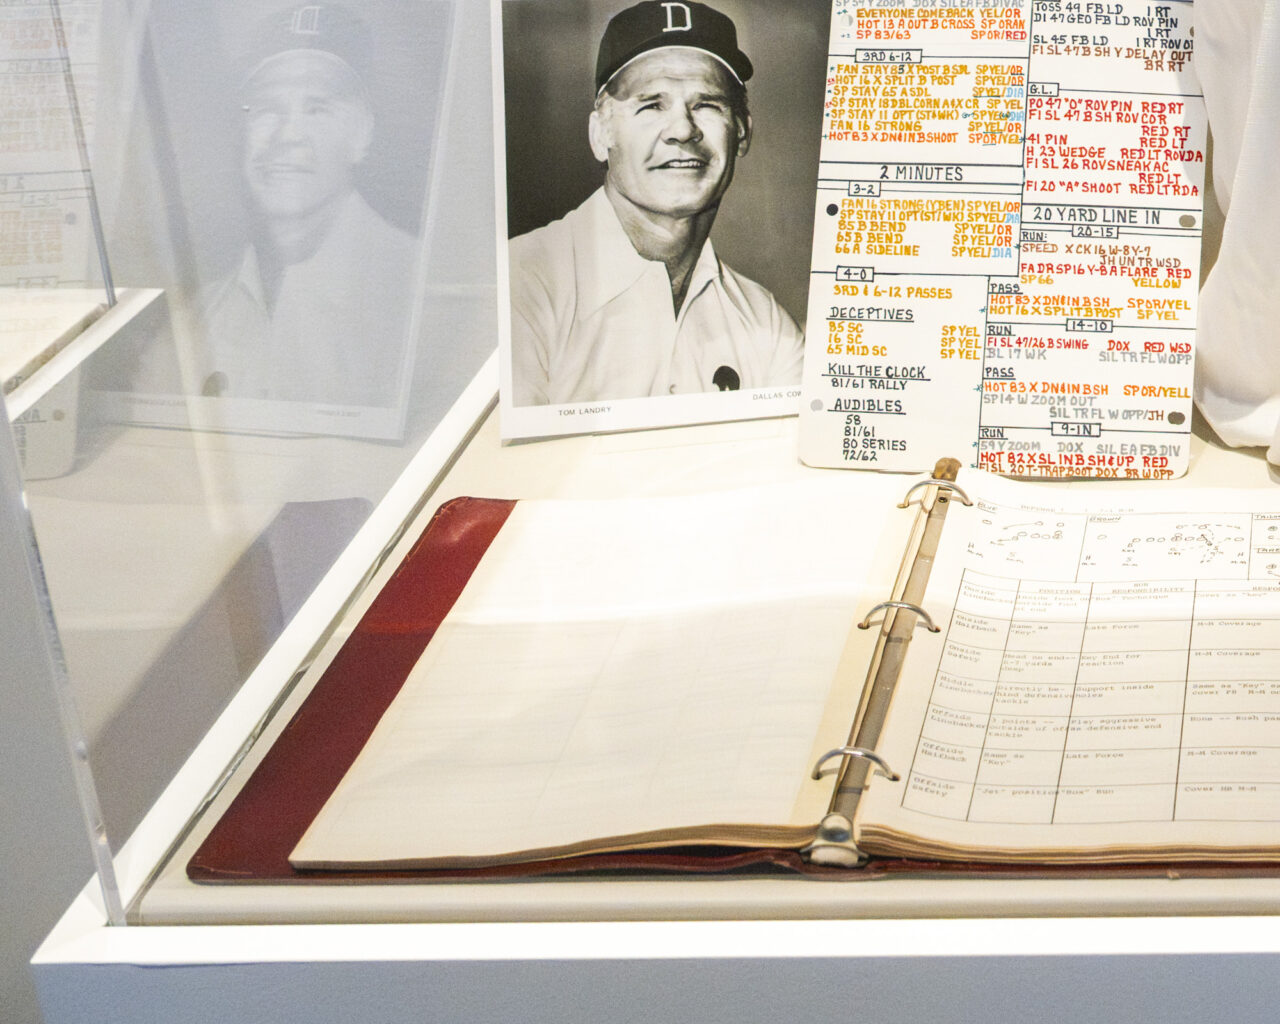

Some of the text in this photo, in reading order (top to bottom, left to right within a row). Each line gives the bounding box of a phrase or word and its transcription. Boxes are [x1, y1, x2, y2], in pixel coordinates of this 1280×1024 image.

[661, 2, 692, 32] D
[856, 9, 1021, 18] EVERYONE COMEBACK YEL/OR
[863, 52, 912, 61] 3RD 6-12
[1030, 85, 1052, 94] G.L.
[1027, 134, 1068, 144] 41 PIN
[1140, 137, 1187, 148] RED LT
[880, 166, 963, 180] 2 MINUTES
[853, 184, 875, 194] 3-2
[1034, 207, 1160, 225] 20 YARD LINE IN
[1078, 227, 1114, 237] 20-15
[844, 269, 867, 279] 4-0
[1132, 278, 1181, 288] YELLOW
[833, 285, 859, 295] 3RD
[874, 286, 901, 297] 6-12
[907, 287, 952, 299] PASSES
[831, 307, 913, 320] DECEPTIVES
[1073, 321, 1107, 330] 14-10
[828, 334, 862, 344] 16 SC
[828, 363, 926, 378] KILL THE CLOCK
[986, 368, 1014, 377] PASS
[831, 378, 908, 390] 81/61 RALLY
[753, 392, 783, 400] DALLAS
[834, 398, 902, 412] AUDIBLES
[845, 415, 861, 425] 58
[844, 426, 875, 437] 81/61
[843, 439, 907, 451] 80 SERIES
[843, 450, 878, 461] 72/62
